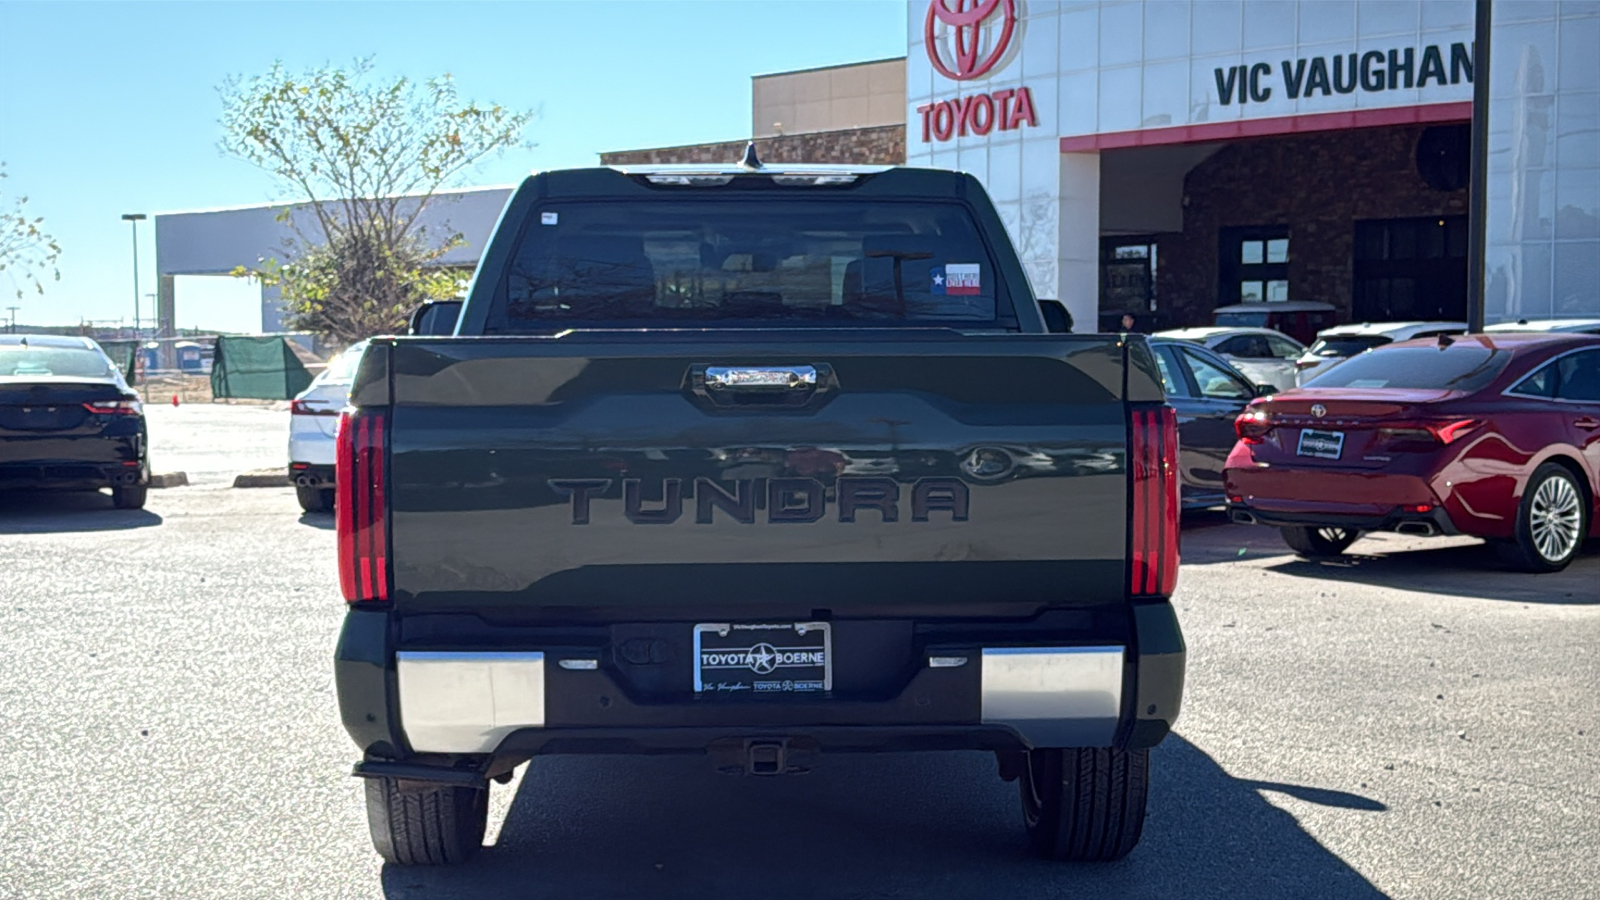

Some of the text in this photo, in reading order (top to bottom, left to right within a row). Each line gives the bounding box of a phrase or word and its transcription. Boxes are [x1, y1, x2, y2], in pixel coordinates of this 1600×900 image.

[1214, 41, 1475, 105] VIC VAUGHAN
[916, 86, 1038, 143] TOYOTA
[547, 477, 970, 525] TUNDRA
[701, 652, 824, 665] TOYOTA BOERNE
[753, 683, 781, 691] TOYOTA
